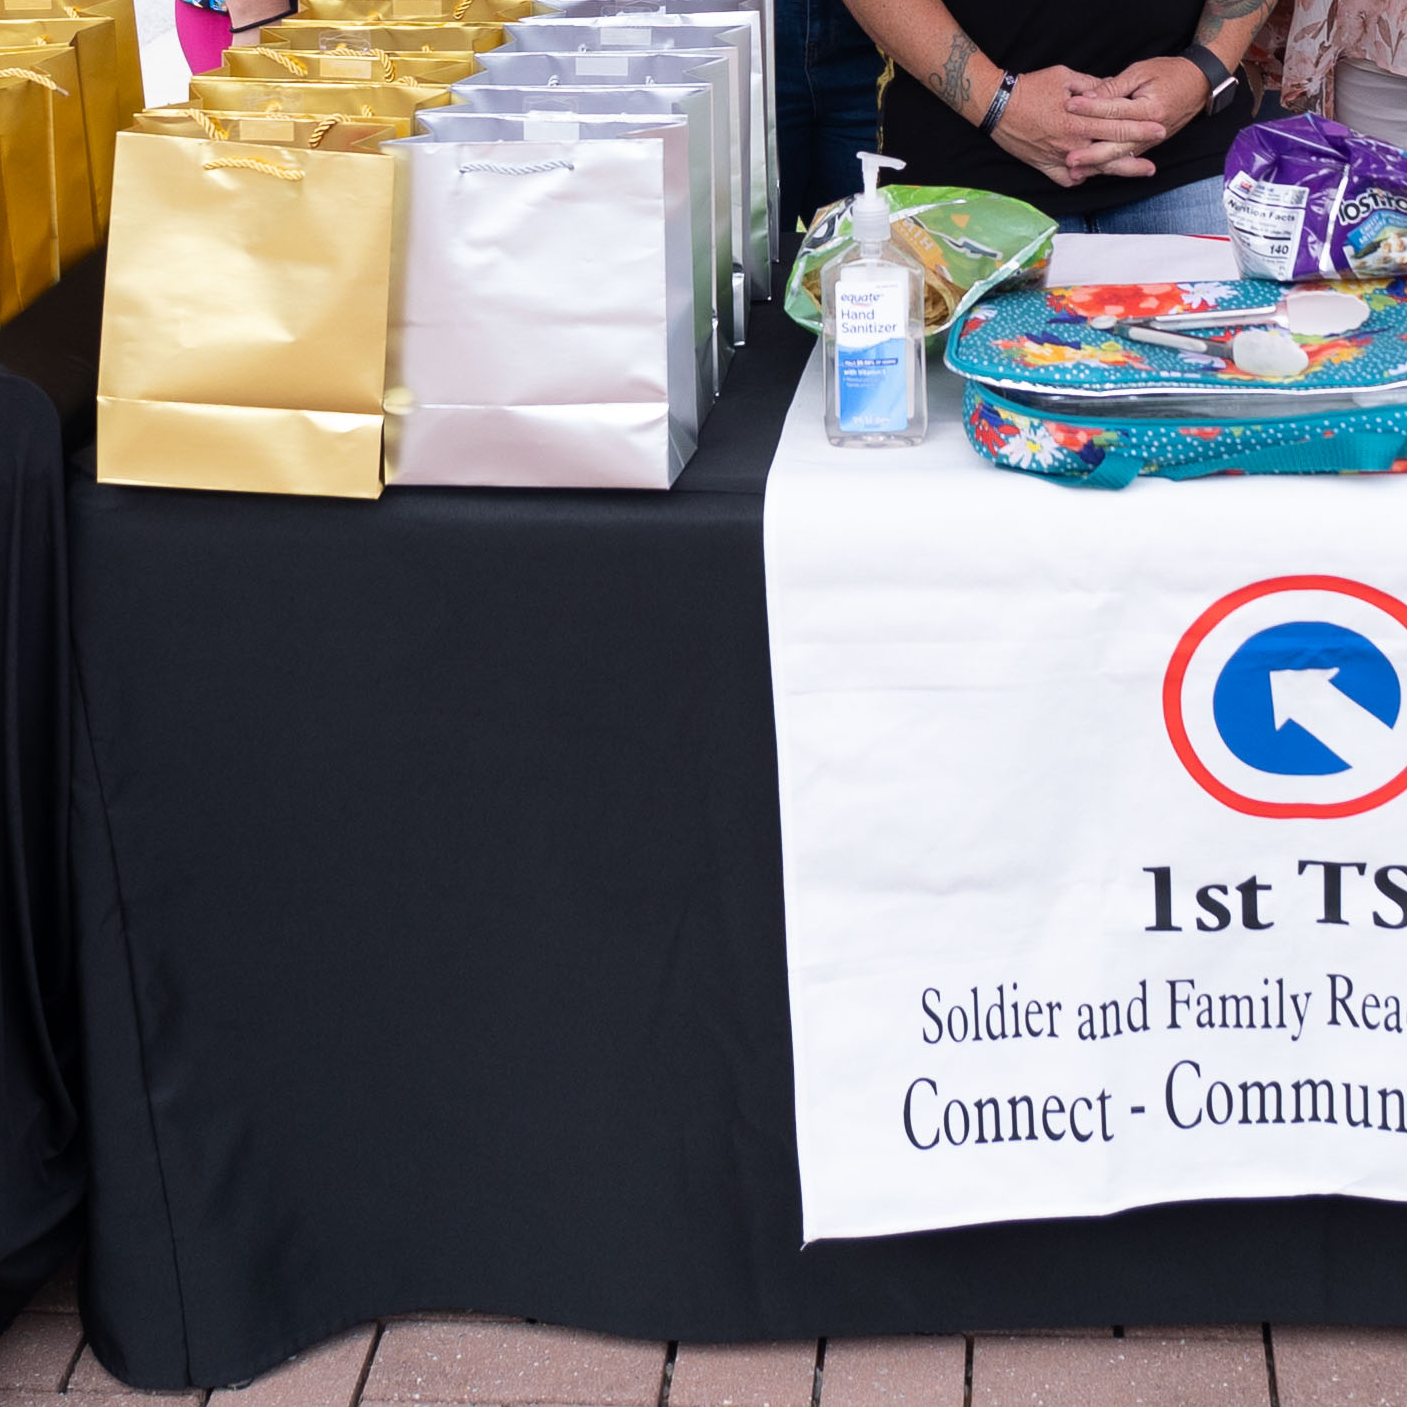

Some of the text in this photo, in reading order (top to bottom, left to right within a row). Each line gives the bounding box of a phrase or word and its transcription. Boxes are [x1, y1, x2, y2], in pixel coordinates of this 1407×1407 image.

[1270, 245, 1289, 255] 140
[841, 293, 880, 304] equate
[841, 309, 875, 320] Hand
[841, 322, 898, 334] Sanitizer
[1142, 866, 1274, 932] 1st
[921, 983, 1062, 1043] Soldier
[1078, 979, 1150, 1040] and
[1166, 977, 1312, 1041] Family
[903, 1077, 1115, 1150] Connect
